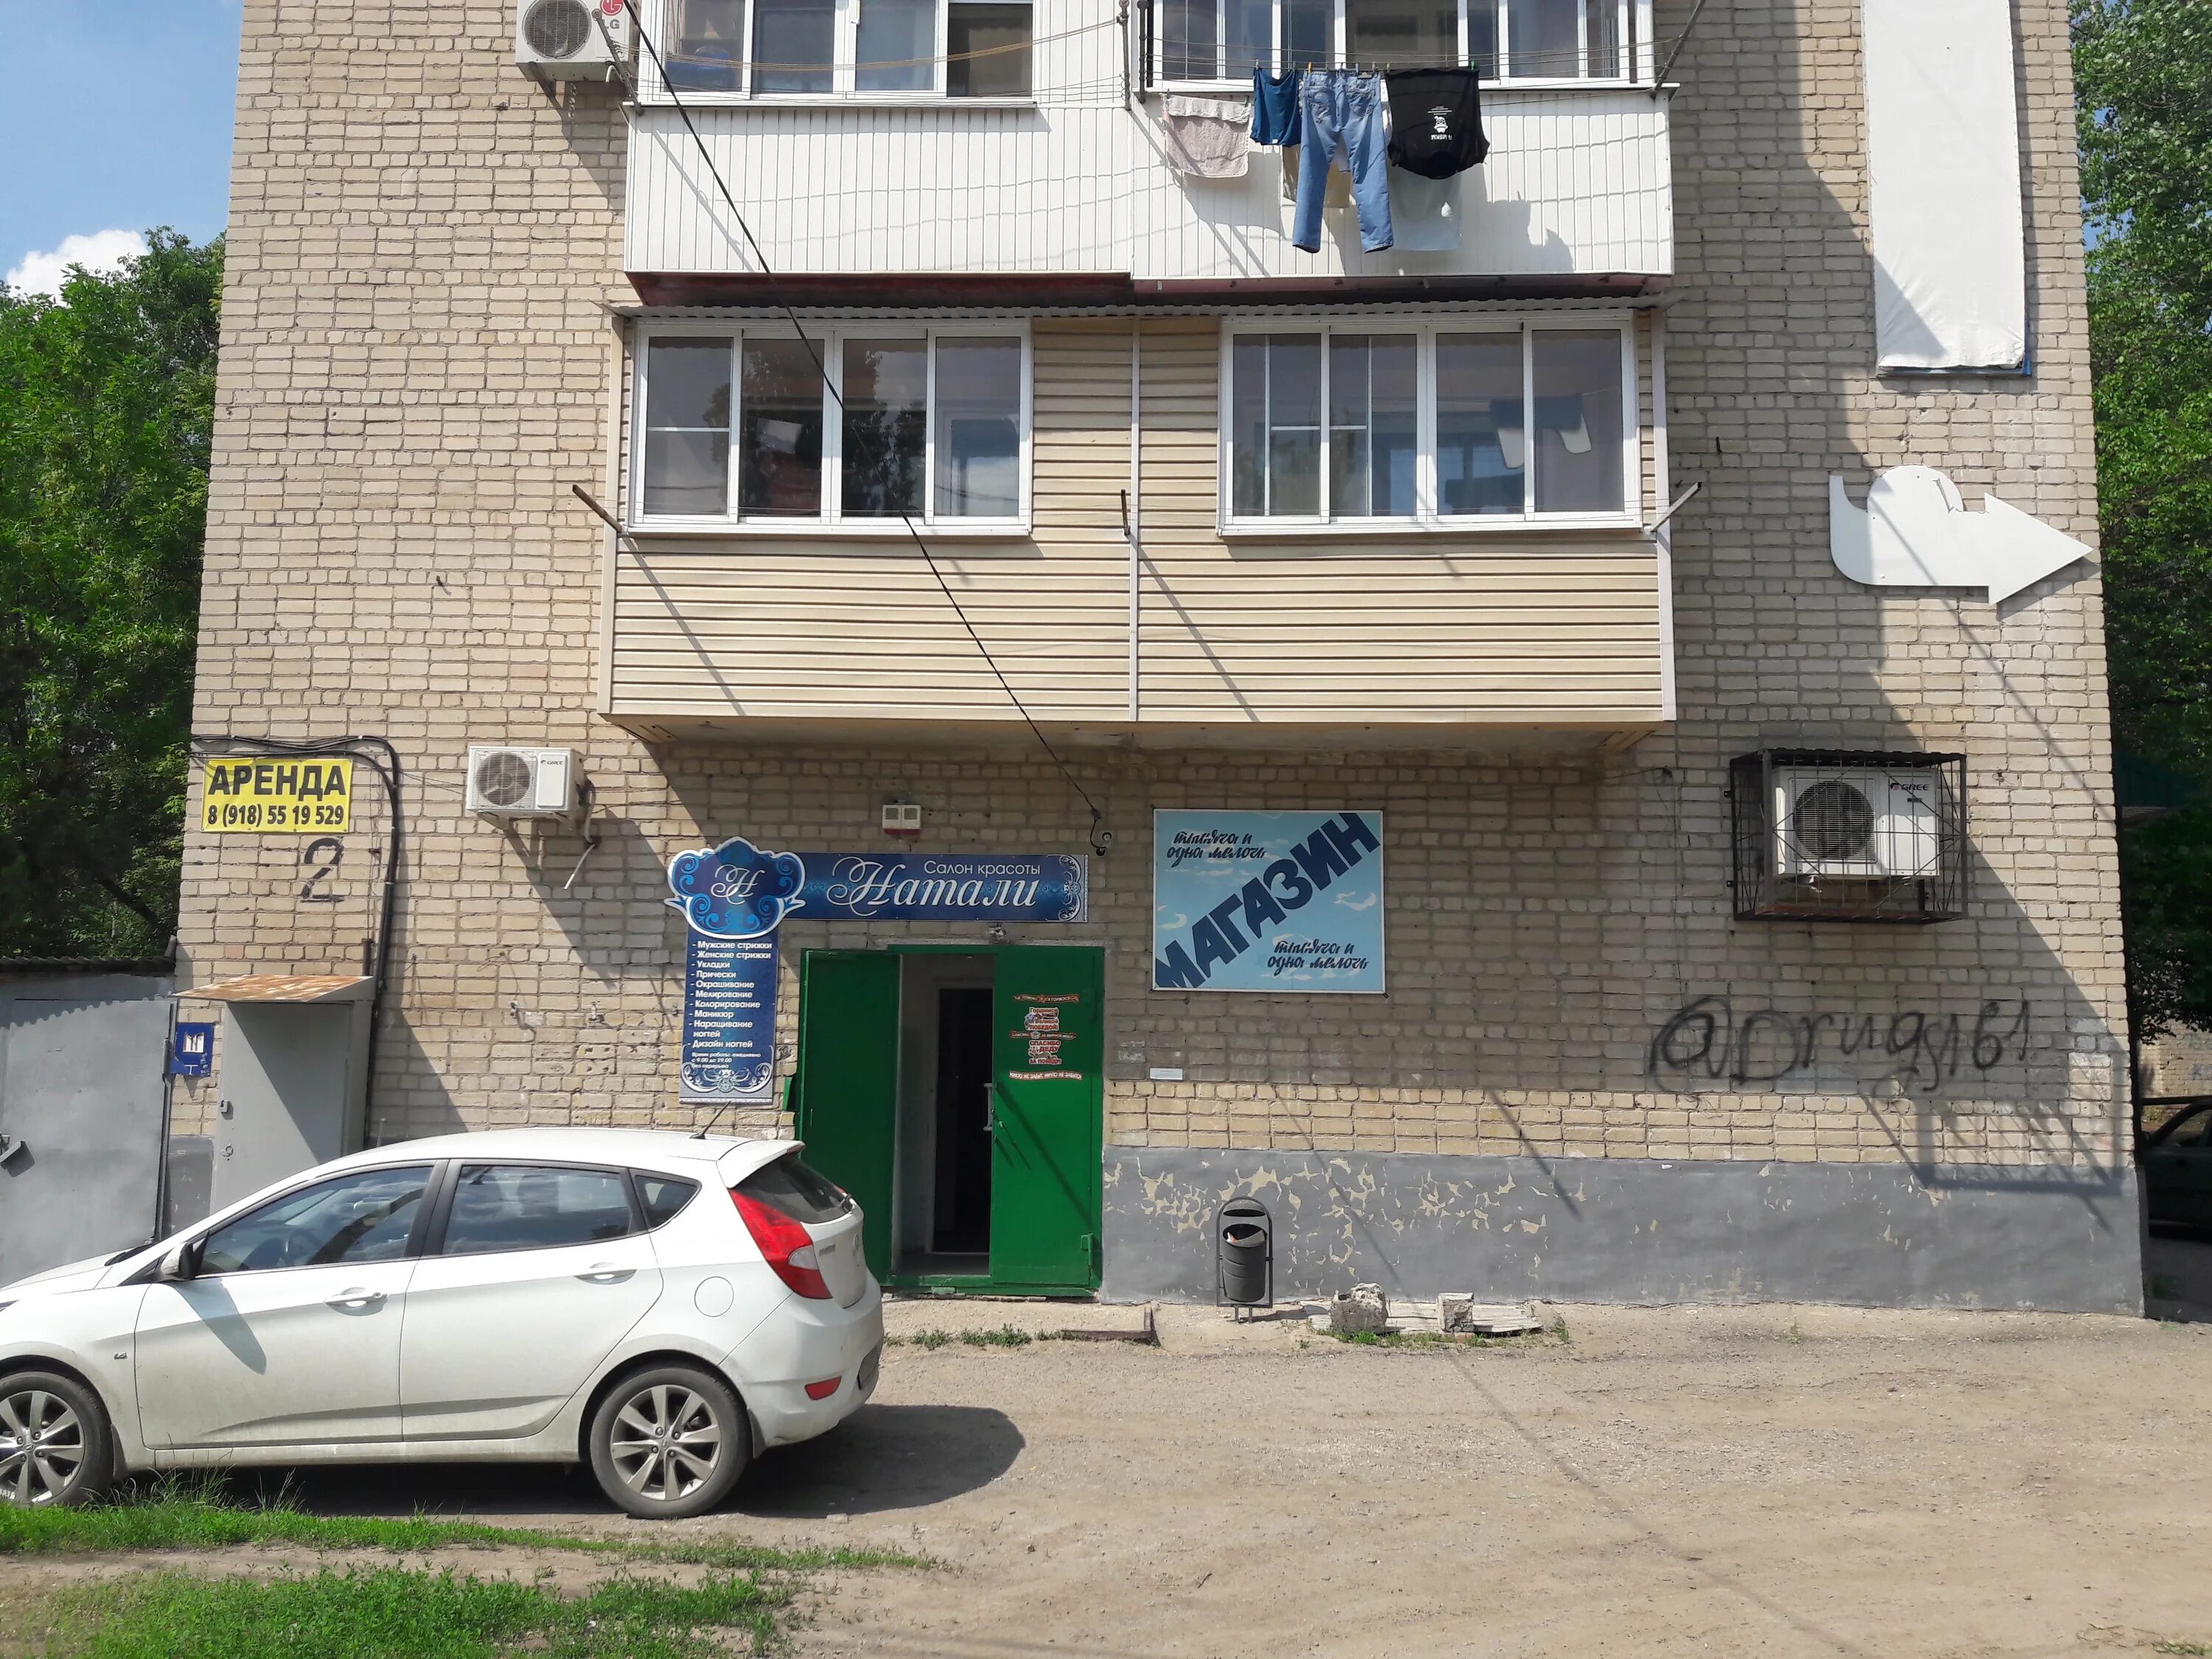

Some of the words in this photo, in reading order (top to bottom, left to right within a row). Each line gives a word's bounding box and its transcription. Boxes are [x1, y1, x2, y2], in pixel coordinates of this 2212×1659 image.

[208, 765, 346, 801] АРЕНДА
[207, 804, 218, 824] 8
[223, 804, 262, 827] (918)
[267, 805, 287, 824] 55
[292, 805, 310, 824] 19
[315, 805, 344, 825] 529
[1166, 846, 1203, 868] одна
[1208, 847, 1267, 858] мелочь
[301, 838, 344, 902] 2
[924, 860, 973, 874] Салон
[978, 863, 1040, 877] красоты
[826, 856, 1040, 917] Натали
[1155, 813, 1380, 988] МАГАЗИН
[698, 941, 735, 950] Мужские
[697, 961, 731, 969] Укладки
[1267, 956, 1305, 977] одна
[1310, 957, 1369, 969] мелочь
[696, 970, 737, 979] Прически
[695, 980, 755, 989] Окрашивание
[695, 990, 753, 999] Мелирование
[695, 1000, 761, 1009] Колорирование
[695, 1010, 734, 1019] Маникюр
[694, 1020, 753, 1029] Наращивание
[692, 1040, 723, 1048] Дизайн
